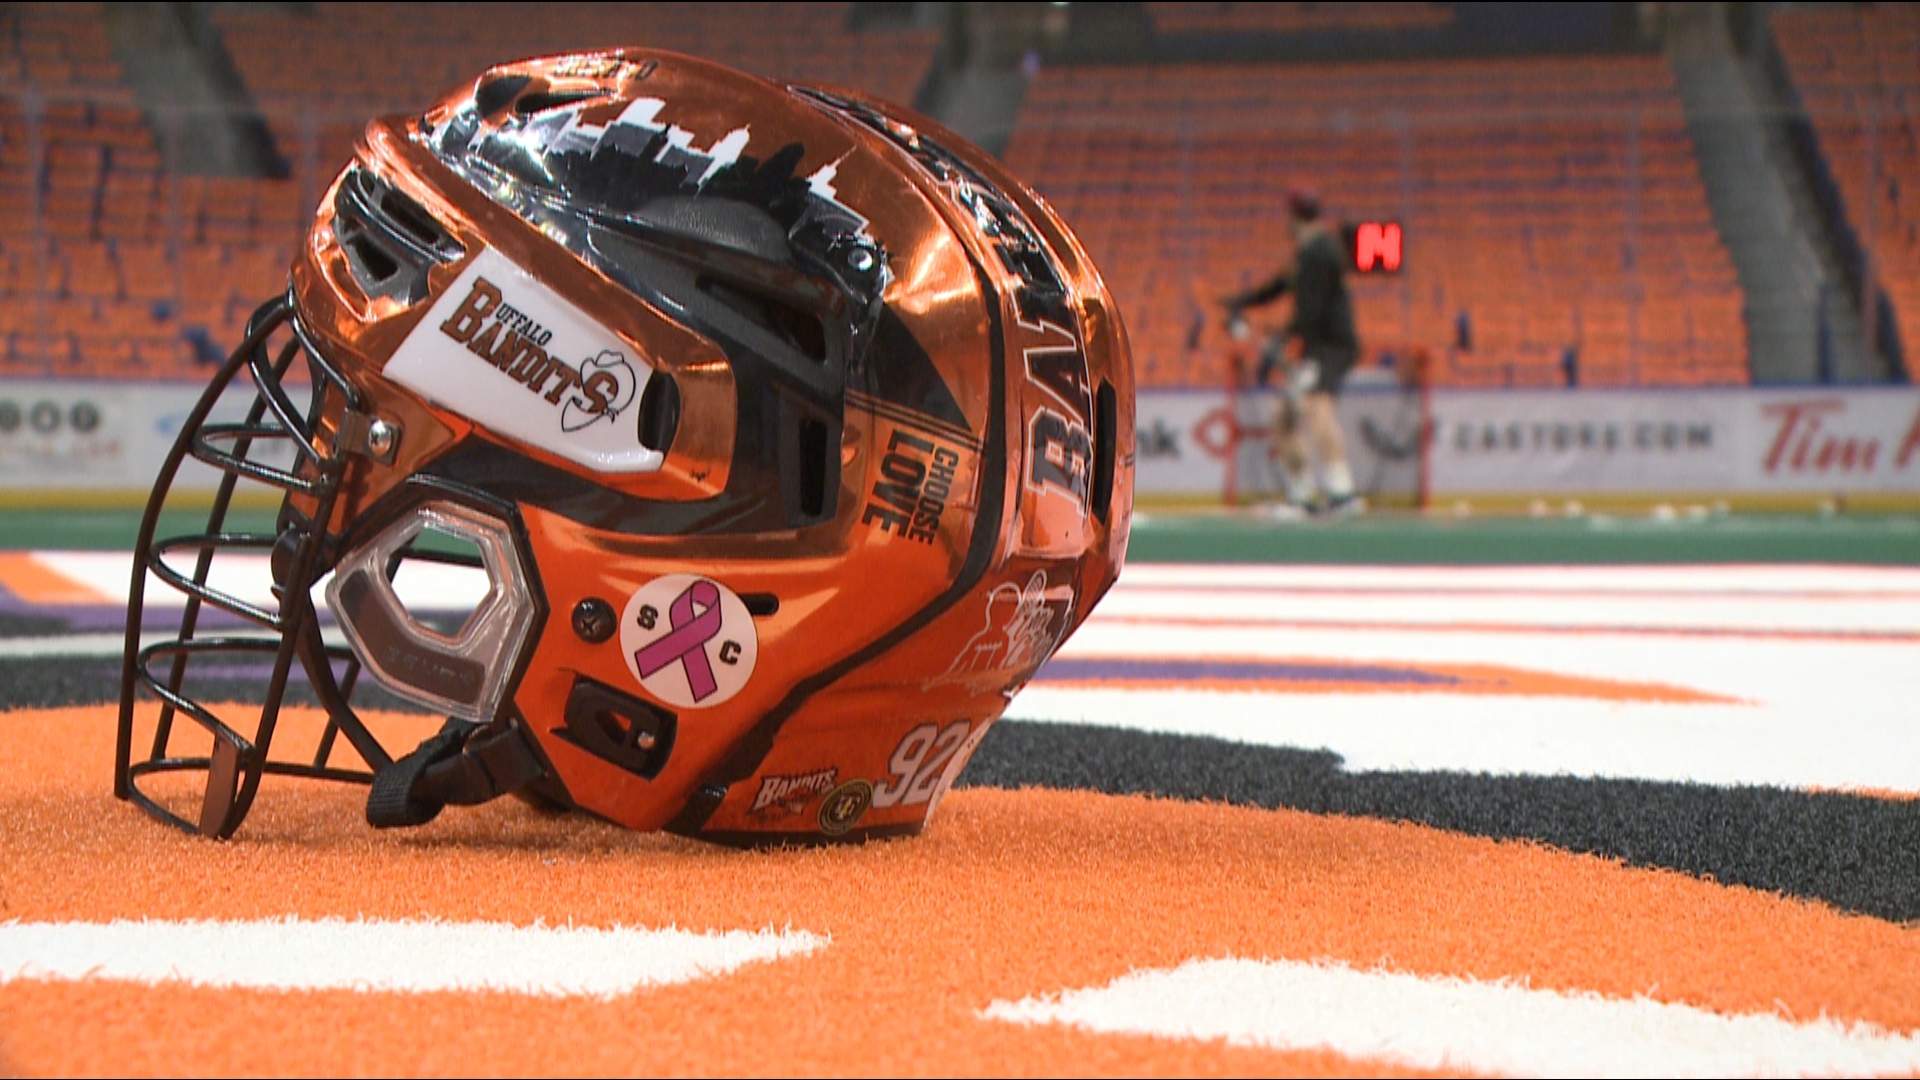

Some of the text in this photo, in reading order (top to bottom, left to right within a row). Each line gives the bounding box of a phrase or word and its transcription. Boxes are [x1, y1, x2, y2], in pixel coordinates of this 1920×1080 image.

[439, 275, 619, 414] BANDITS
[1760, 398, 1882, 475] Tim
[861, 429, 935, 538] LOVE
[907, 445, 959, 546] CHOOSE
[718, 639, 742, 666] C
[747, 769, 838, 815] BANDITS
[872, 719, 971, 808] 92
